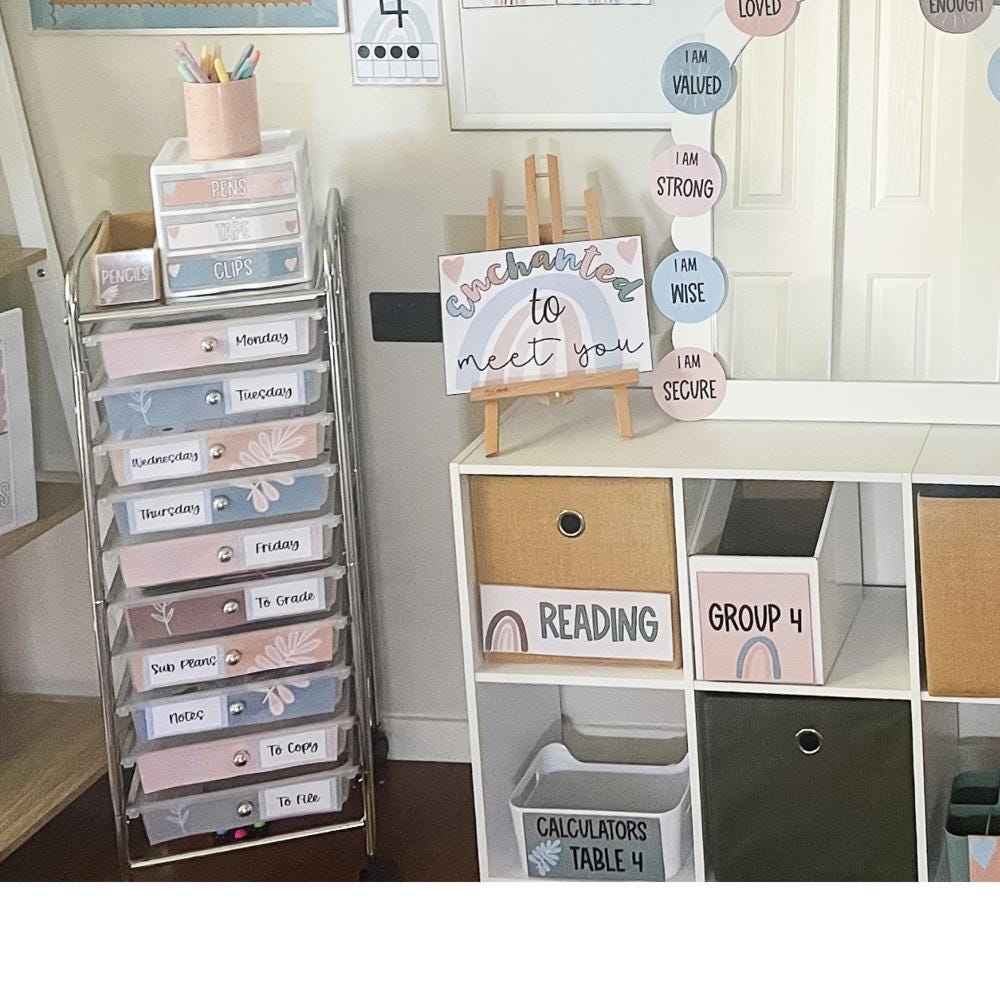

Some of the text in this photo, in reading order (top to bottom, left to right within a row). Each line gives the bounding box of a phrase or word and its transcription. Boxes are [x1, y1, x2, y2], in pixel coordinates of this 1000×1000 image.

[673, 75, 721, 95] VALUED
[211, 179, 247, 198] PENS
[656, 176, 713, 199] STRONG
[214, 257, 252, 280] CLIPS
[671, 283, 705, 304] WISE
[530, 288, 566, 325] to
[236, 332, 288, 347] Monday
[458, 337, 643, 372] meet you
[236, 384, 292, 401] Tuesday
[663, 378, 717, 402] SECURE
[132, 449, 198, 469] Wednesday
[139, 502, 200, 521] Thursday
[255, 537, 299, 554] Friday
[255, 591, 314, 609] To Grade
[539, 602, 658, 642] READING
[709, 603, 802, 633] GROUP 4
[267, 741, 318, 756] To Copy
[537, 817, 647, 841] CALCULATORS
[570, 846, 643, 872] TABLE 4
